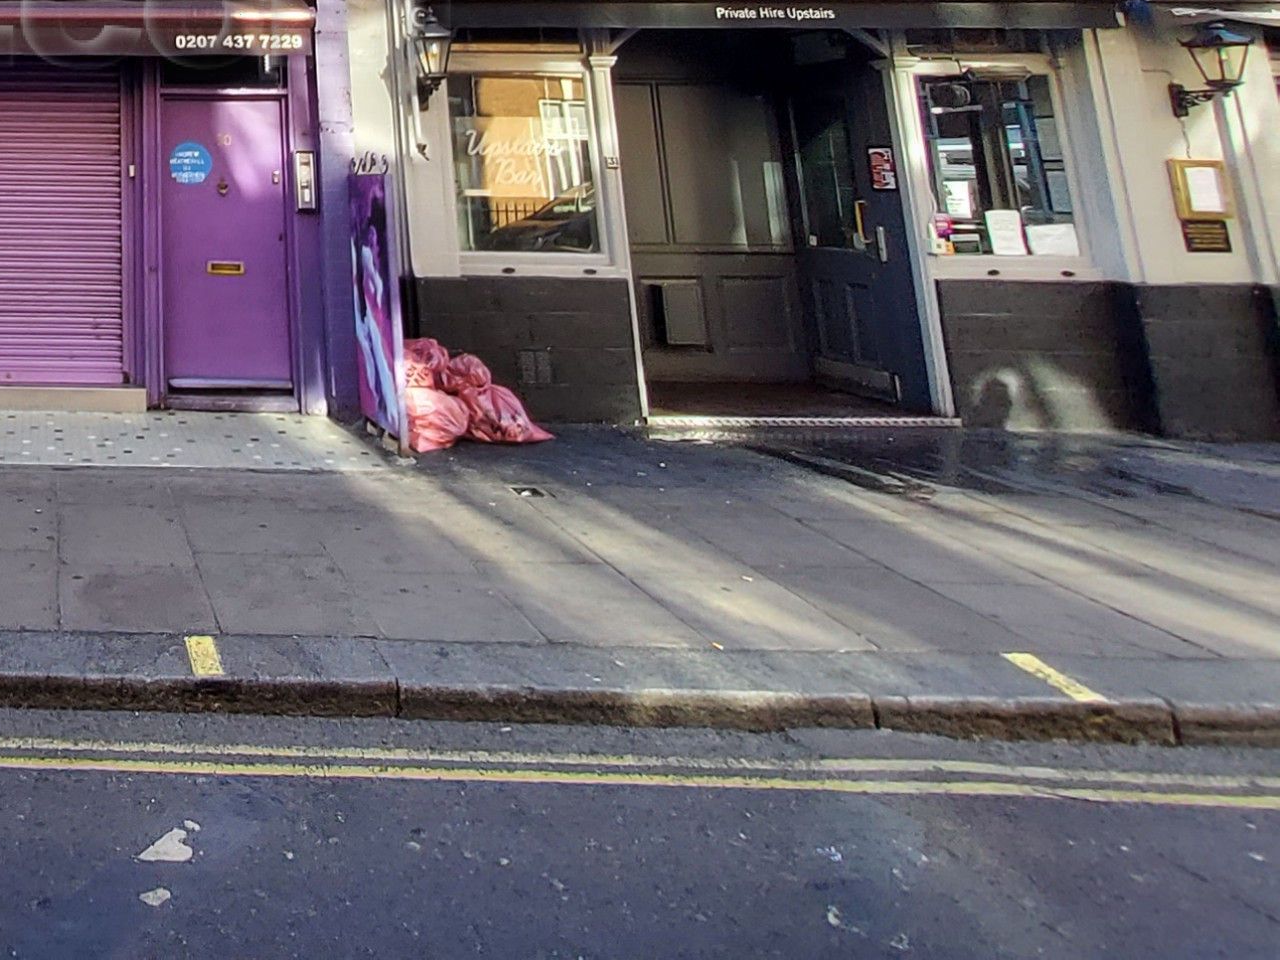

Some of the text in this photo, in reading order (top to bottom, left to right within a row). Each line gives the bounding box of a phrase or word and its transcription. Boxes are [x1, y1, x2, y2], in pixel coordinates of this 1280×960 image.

[715, 6, 836, 21] Private Hire Upstairs
[175, 34, 303, 49] 0207 437 7229
[495, 158, 543, 186] Bar
